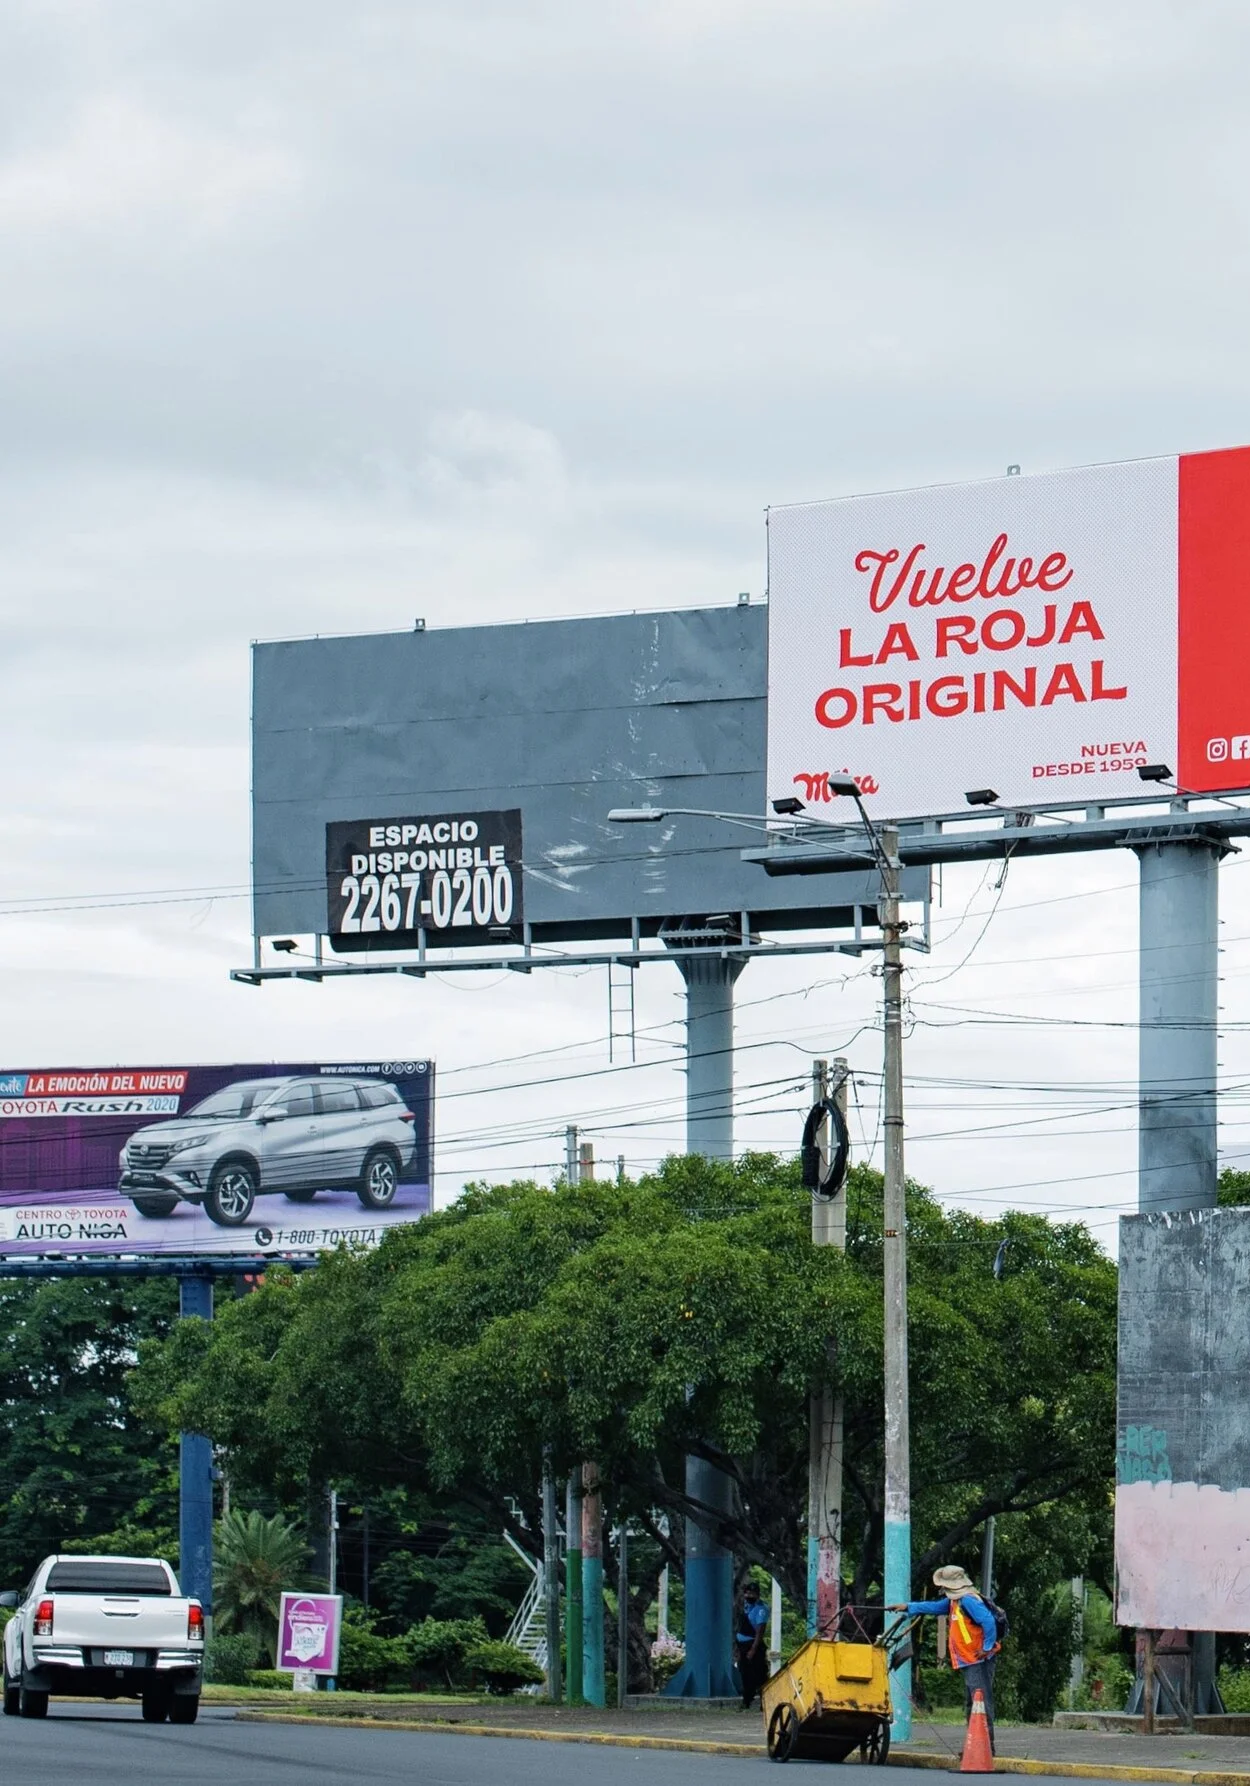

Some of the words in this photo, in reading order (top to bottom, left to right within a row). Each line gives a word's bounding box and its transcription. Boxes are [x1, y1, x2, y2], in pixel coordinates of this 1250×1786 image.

[855, 533, 1073, 613] Vuelve
[839, 621, 919, 668] LA
[935, 600, 1105, 658] ROJA
[815, 660, 1127, 729] ORIGINAL
[1081, 741, 1147, 757] NUEVA
[1032, 761, 1095, 778] DESDE
[369, 820, 479, 848] ESPACIO
[351, 845, 506, 876] DISPONIBLE
[341, 865, 513, 933] 2267-0200
[28, 1078, 44, 1092] LA
[48, 1073, 108, 1091] EMOCIÓN
[112, 1076, 135, 1091] DEL
[140, 1075, 184, 1090] NUEVO
[0, 1101, 57, 1114] OYOTA
[62, 1099, 143, 1113] Rush
[146, 1098, 177, 1111] 2020
[16, 1210, 61, 1219] CENTRO
[83, 1209, 127, 1219] TOYOTA
[16, 1223, 72, 1239] AUTO
[79, 1223, 127, 1239] NICA
